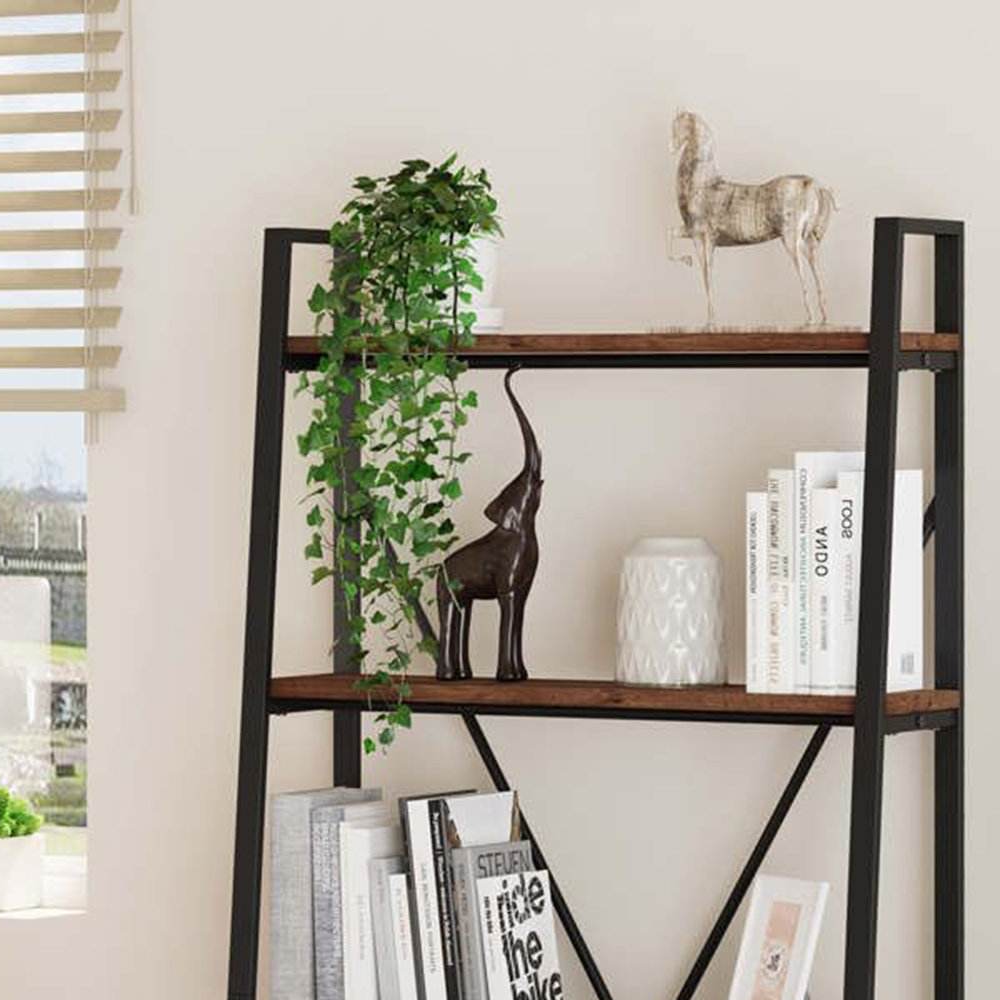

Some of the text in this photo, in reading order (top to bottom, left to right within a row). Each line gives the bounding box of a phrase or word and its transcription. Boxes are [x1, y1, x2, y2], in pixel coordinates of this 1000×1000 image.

[477, 850, 531, 879] STEVEN
[497, 873, 545, 934] ride
[501, 930, 544, 983] the
